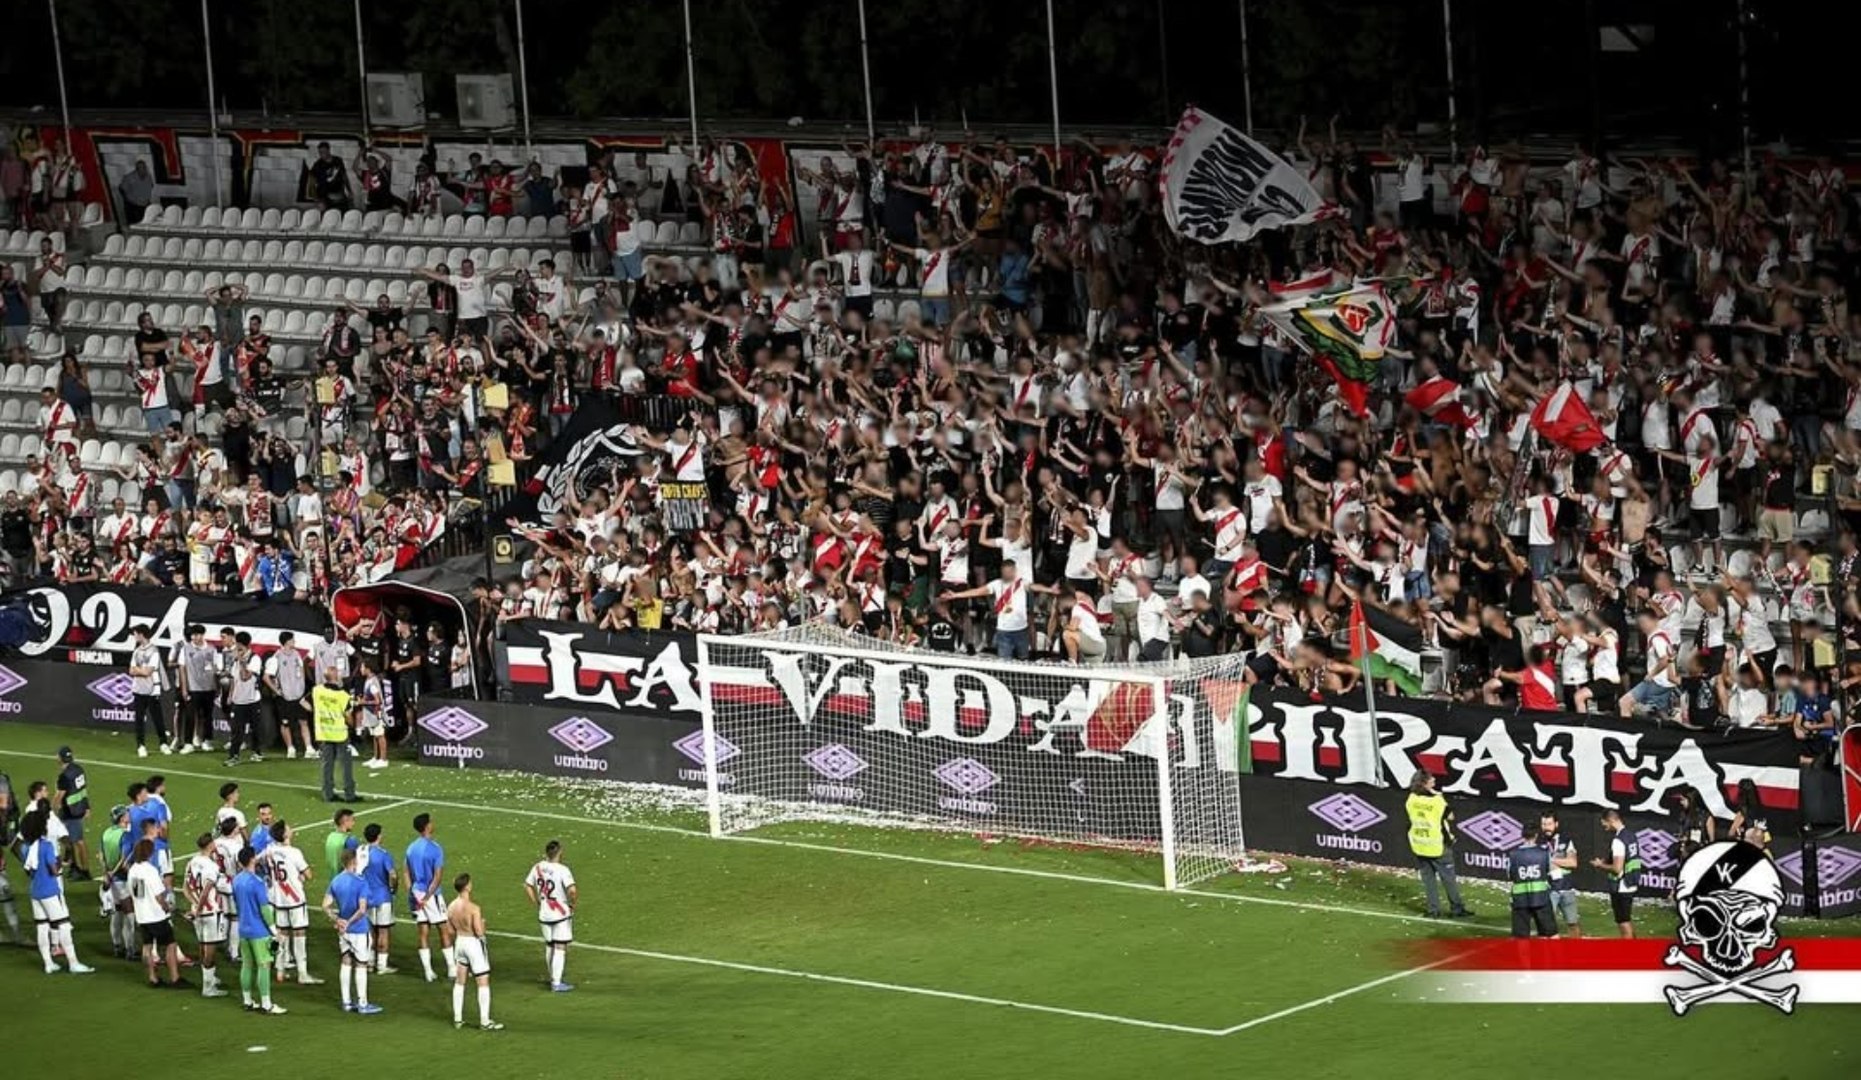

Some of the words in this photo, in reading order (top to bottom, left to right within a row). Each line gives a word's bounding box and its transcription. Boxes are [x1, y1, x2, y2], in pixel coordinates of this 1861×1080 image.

[538, 629, 714, 713] LA
[423, 743, 484, 760] umbro
[554, 754, 608, 771] umbro
[1315, 832, 1383, 853] umbro
[1517, 864, 1541, 881] 645
